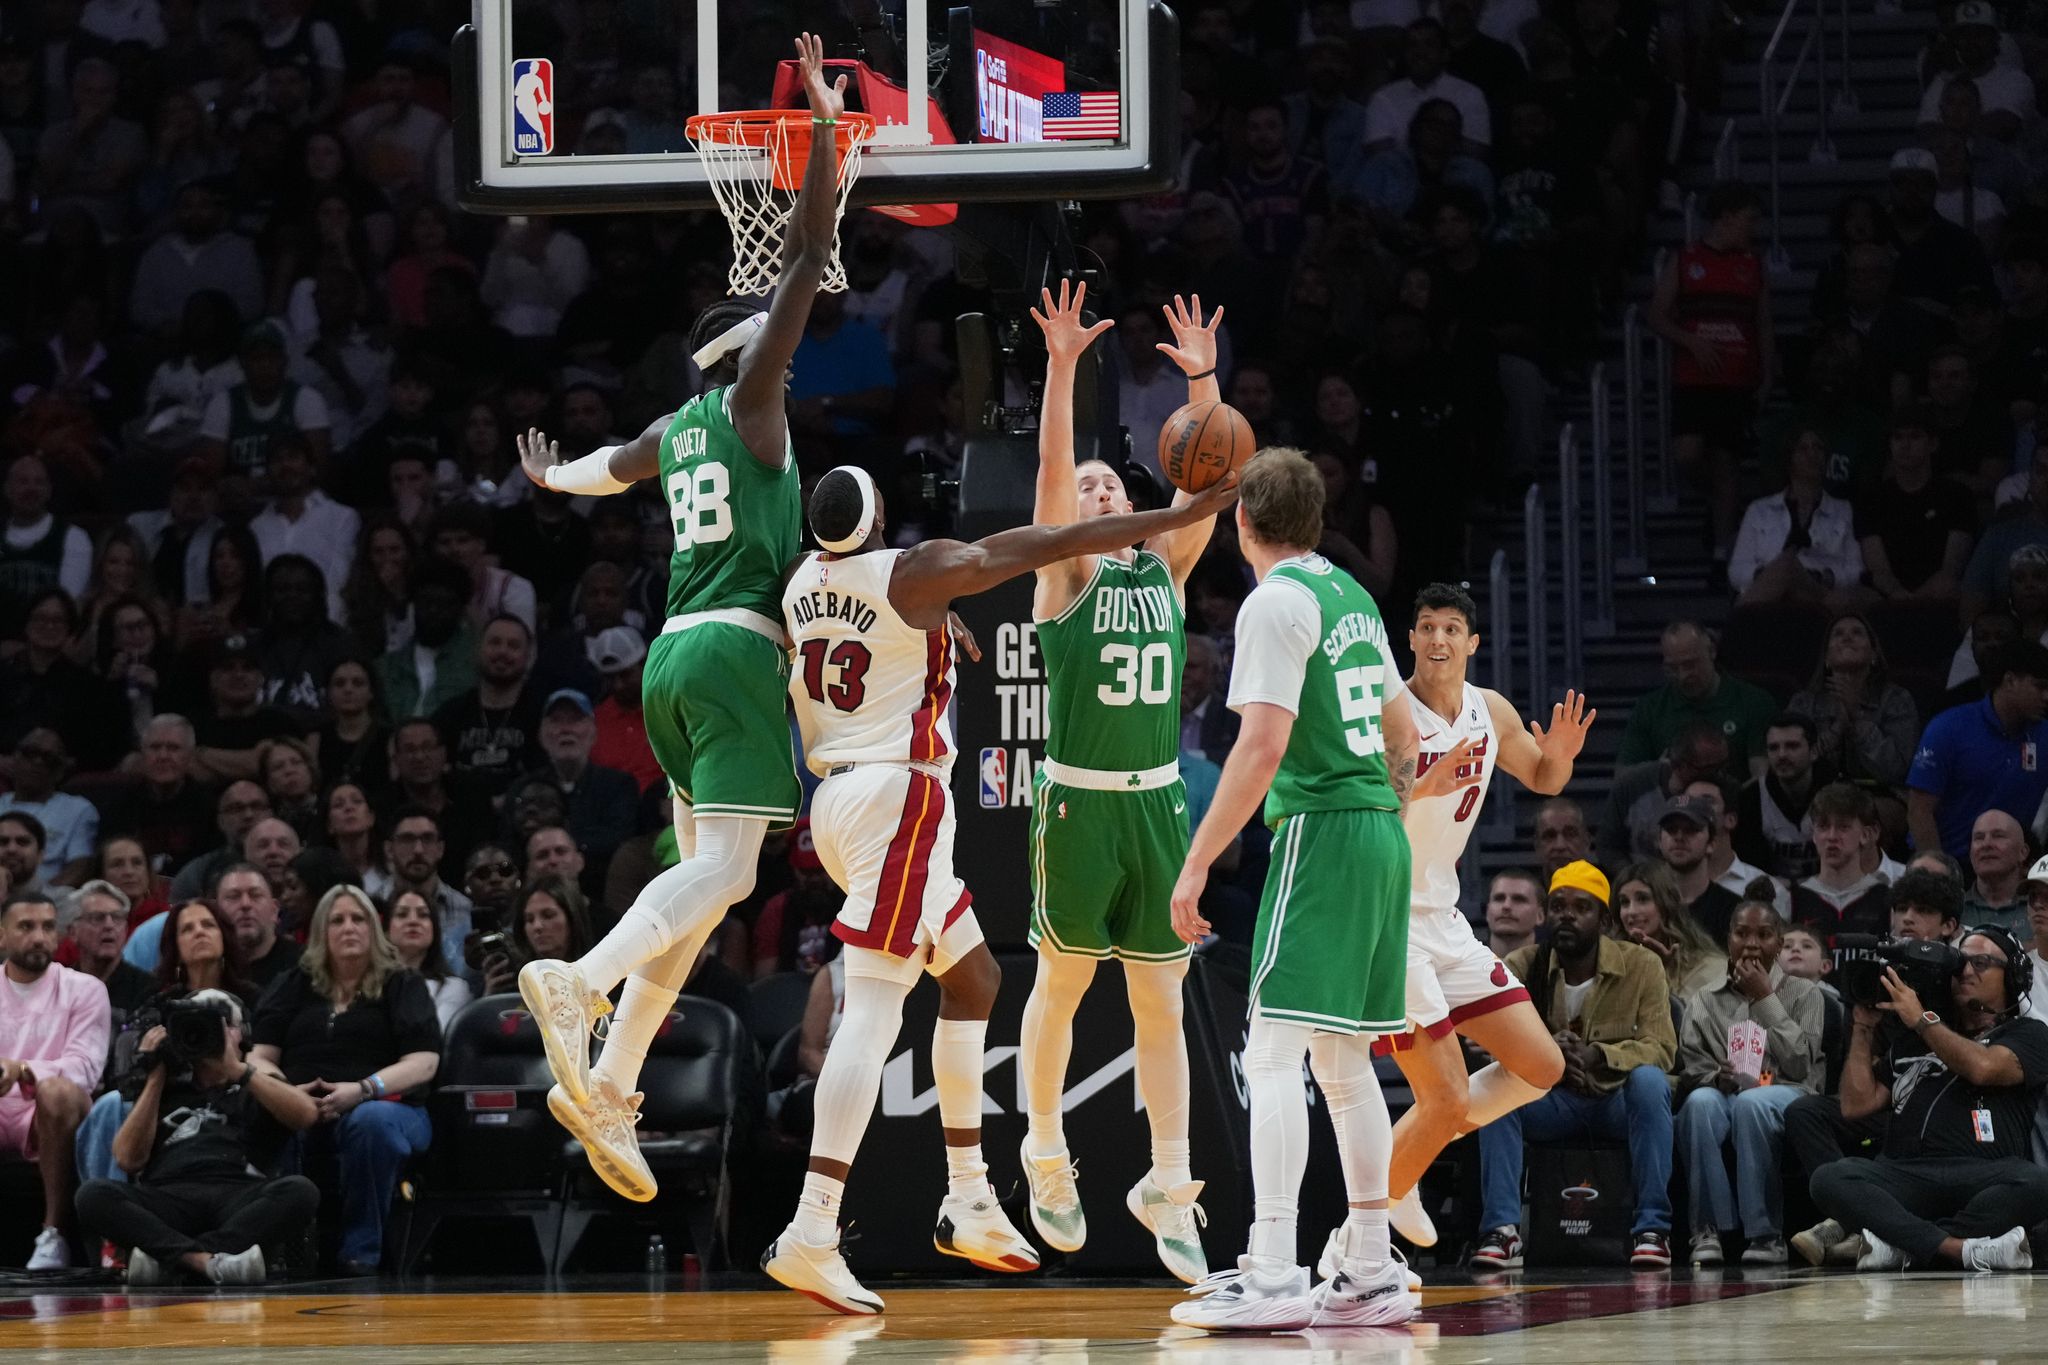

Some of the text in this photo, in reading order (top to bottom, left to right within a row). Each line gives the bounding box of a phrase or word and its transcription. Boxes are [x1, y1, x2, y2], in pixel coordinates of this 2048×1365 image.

[518, 134, 538, 149] NBA
[671, 427, 707, 462] QUETA
[1170, 420, 1199, 479] Wilson
[667, 461, 733, 553] 88
[793, 591, 876, 634] ADEBAYO
[1093, 585, 1173, 633] BOSTON
[996, 622, 1048, 679] GE
[1097, 642, 1172, 706] 30
[800, 638, 872, 713] 13
[1335, 664, 1385, 757] 55
[1454, 785, 1480, 822] 0
[1560, 1220, 1590, 1228] MIAMI
[1566, 1225, 1593, 1235] HEAT
